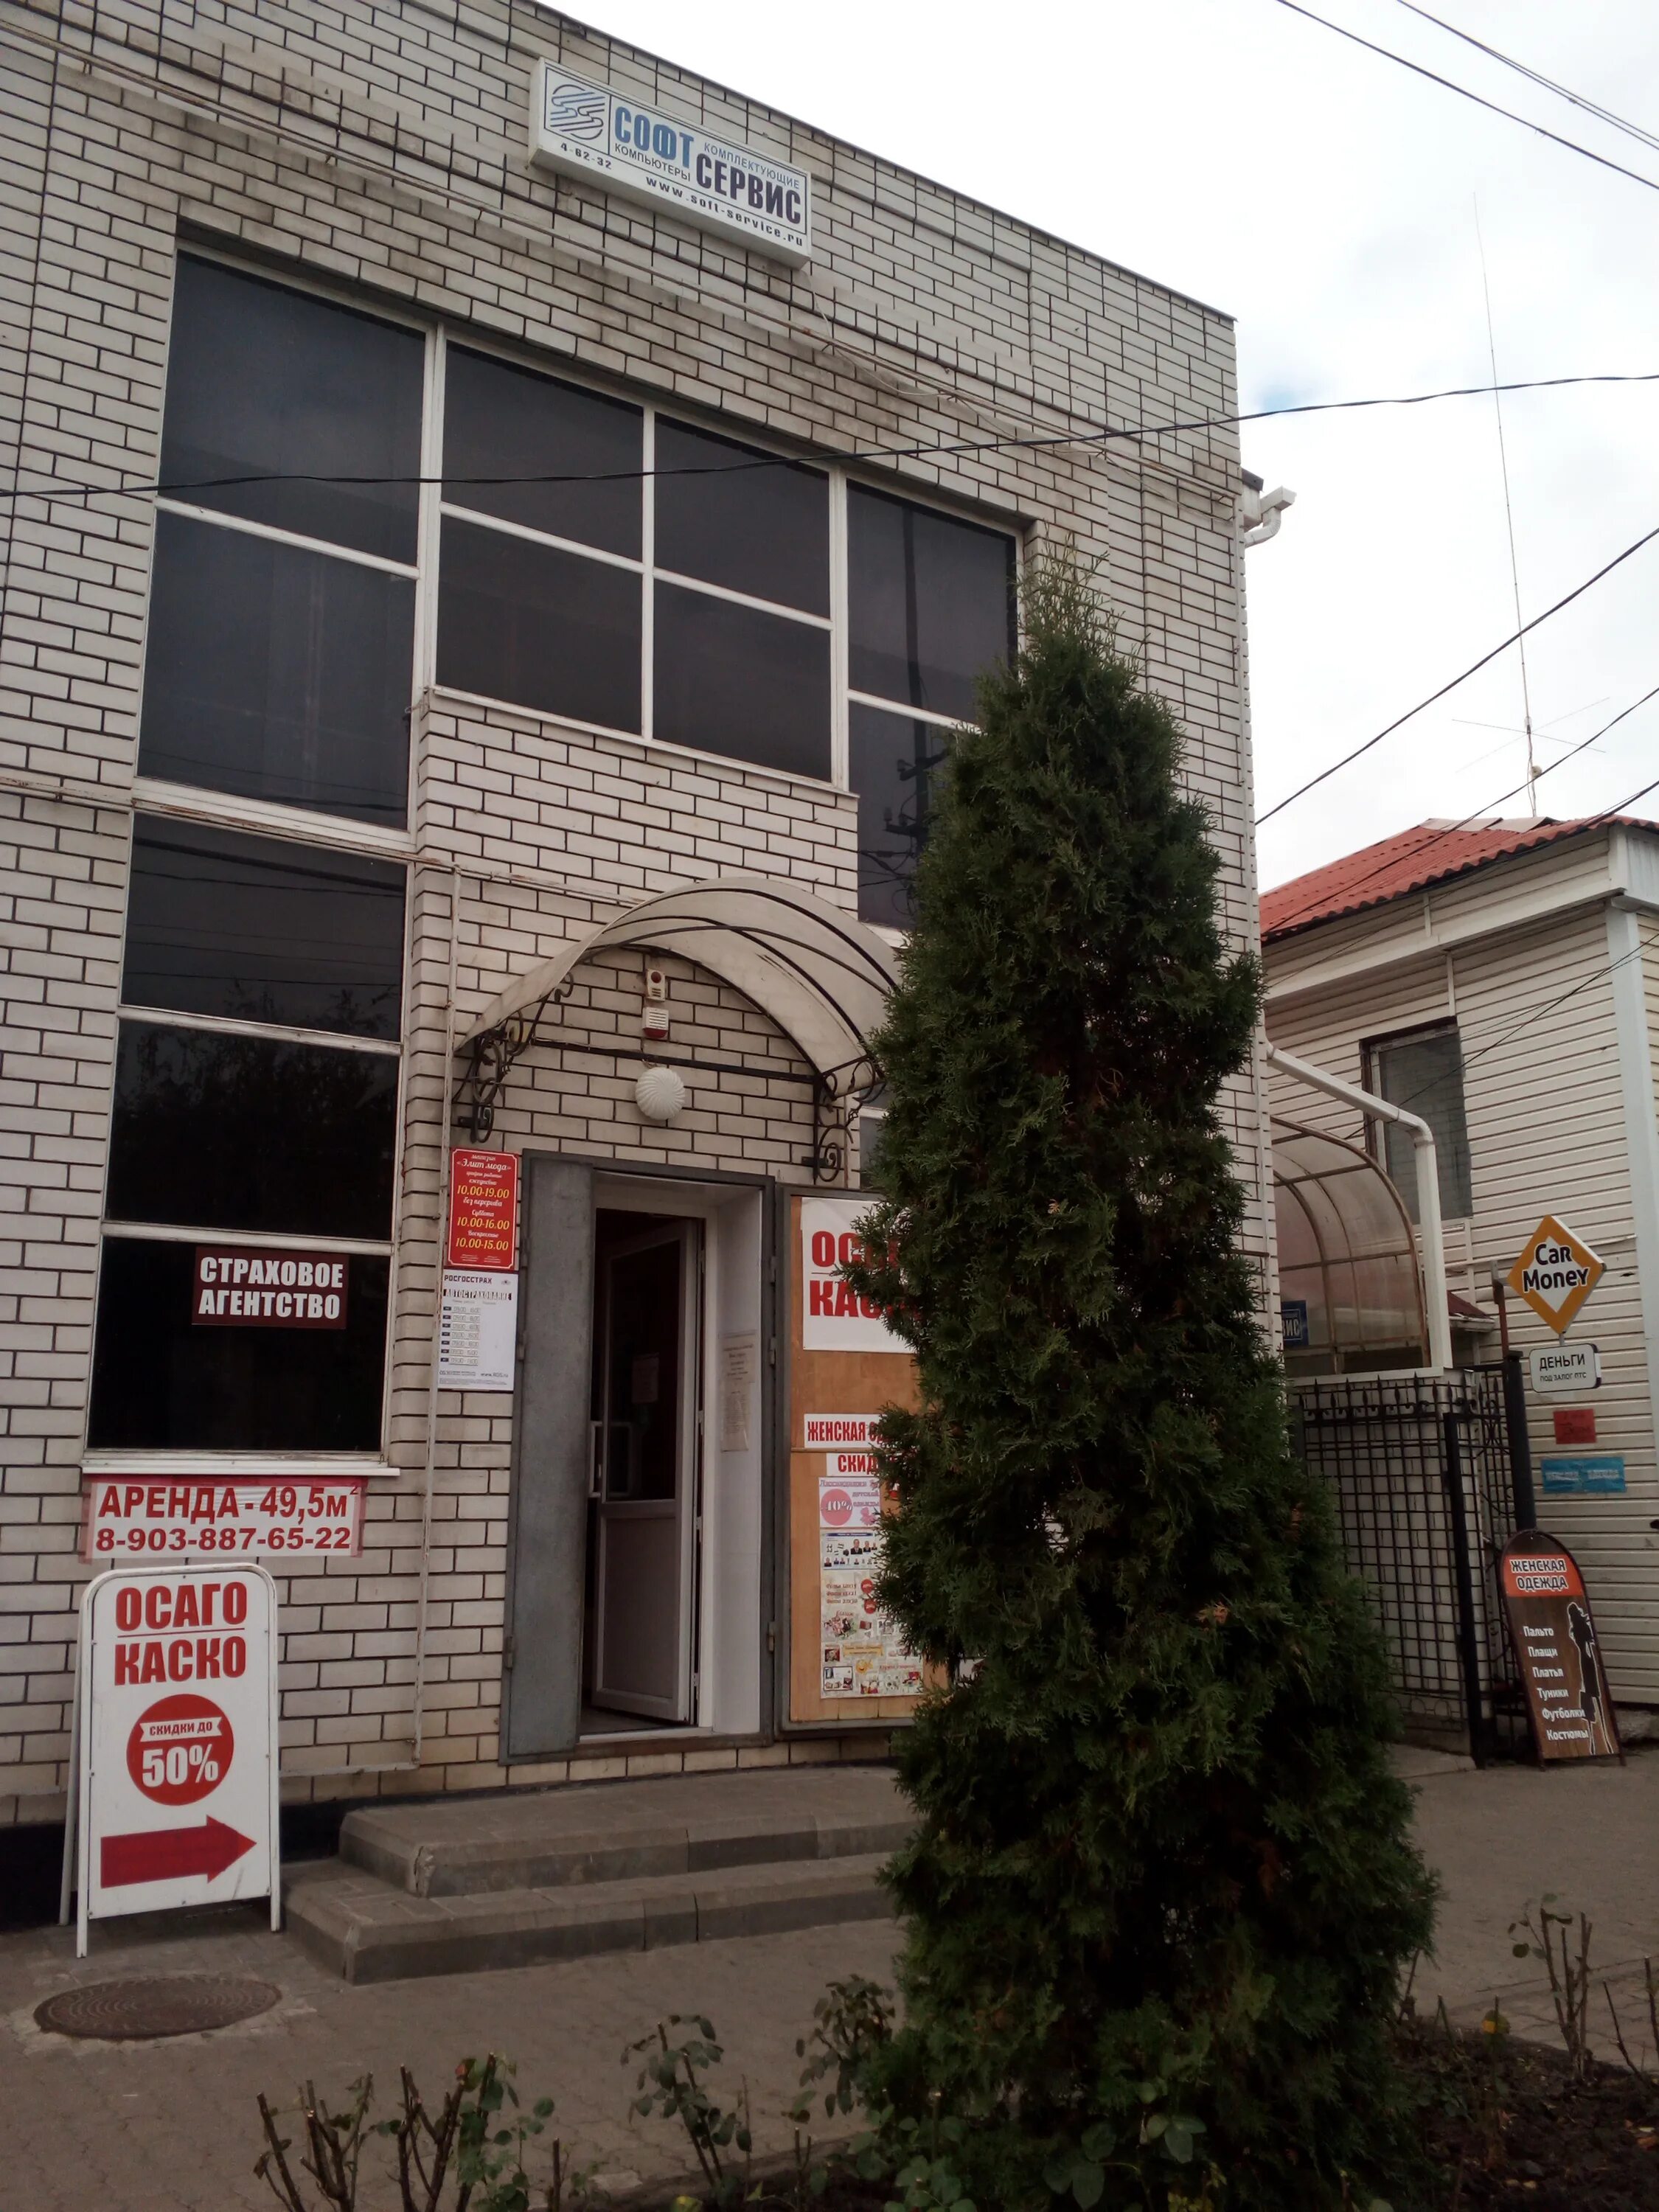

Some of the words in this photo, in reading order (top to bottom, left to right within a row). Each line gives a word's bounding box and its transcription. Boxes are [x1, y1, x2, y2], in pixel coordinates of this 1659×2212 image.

[614, 105, 694, 168] СОФТ
[560, 142, 612, 170] 4-62-32
[614, 143, 691, 183] КОМПЬЮТЕРЫ
[703, 142, 800, 189] КОМПЛЕКТУЮЩИЕ
[696, 153, 801, 225] СЕРВИС
[457, 1185, 509, 1198] 10.00-19.00
[457, 1217, 509, 1230] 10.00-16.00
[456, 1237, 509, 1251] 10.00-15.00
[199, 1256, 344, 1288] СТРАХОВОЕ
[444, 1275, 492, 1284] РОСГОССТРАХ
[198, 1289, 340, 1320] АГЕНТСТВО
[1539, 1354, 1585, 1371] ДЕНЬГИ
[1540, 1374, 1553, 1382] ПОД
[1554, 1373, 1573, 1382] ЗАЛОГ
[807, 1421, 866, 1441] ЖЕНСКАЯ
[96, 1527, 352, 1553] 8-903-887-65-22
[1510, 1558, 1567, 1572] ЖЕНСКАЯ
[1516, 1575, 1568, 1592] ОДЕЖДА
[114, 1581, 248, 1632] ОСАГО
[1523, 1626, 1554, 1638] Пальто
[114, 1635, 247, 1686] КАСКО
[1527, 1646, 1558, 1658] Плащи
[1533, 1666, 1564, 1678] Платья
[1537, 1686, 1569, 1700] Туники
[1542, 1707, 1585, 1722] Футболки
[1545, 1729, 1590, 1742] Костюмы
[142, 1743, 219, 1788] 50%
